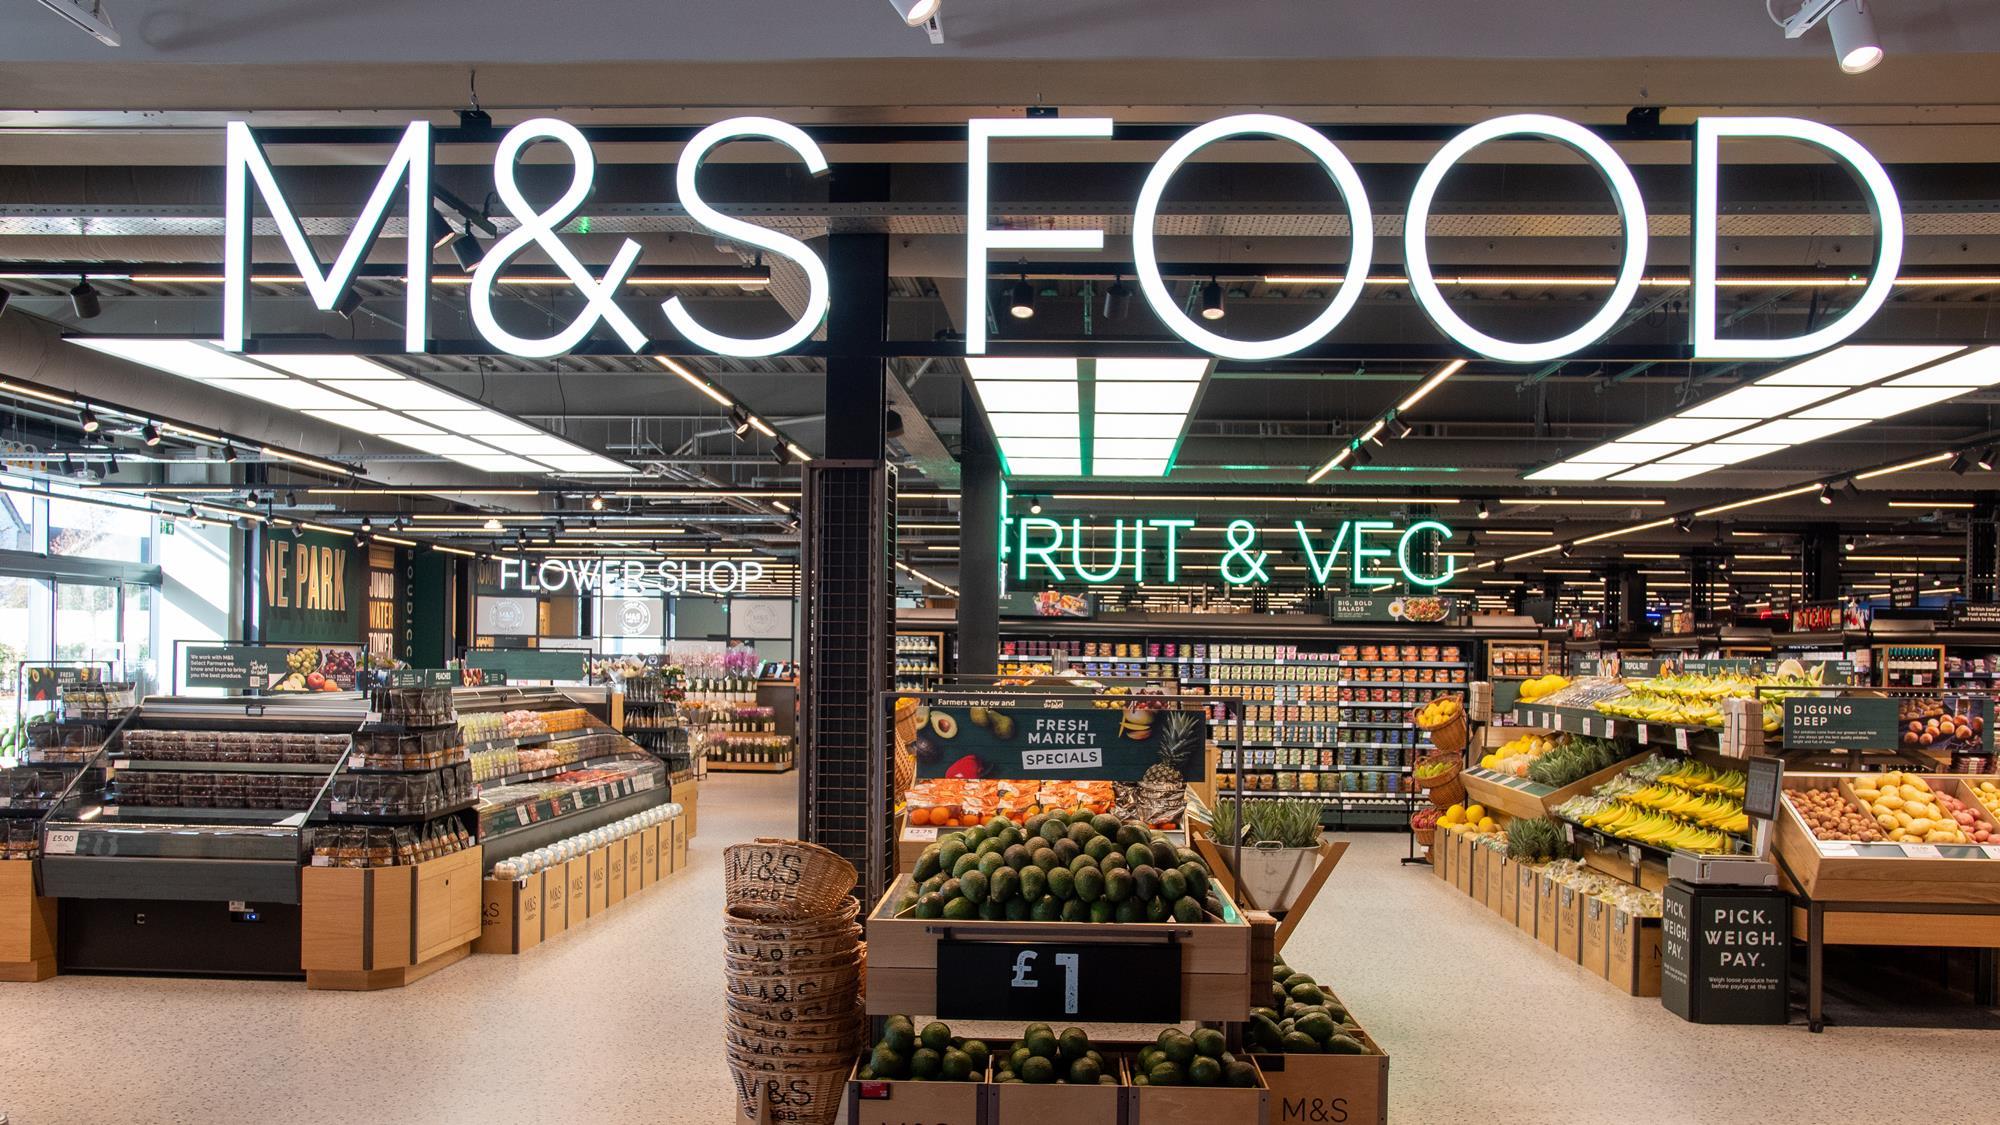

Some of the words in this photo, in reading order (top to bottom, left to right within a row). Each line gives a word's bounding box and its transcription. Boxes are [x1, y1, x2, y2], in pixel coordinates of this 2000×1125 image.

[224, 116, 830, 357] M&S
[965, 114, 1904, 361] FOOD
[1219, 519, 1270, 585] &
[1294, 520, 1455, 587] VEG
[295, 543, 346, 611] PARK
[369, 571, 394, 599] JUMBO
[501, 559, 645, 592] FLOWER
[658, 561, 763, 592] SHOP
[369, 601, 394, 629] WATER
[1797, 607, 1832, 628] STEAK
[368, 632, 394, 658] TOWER
[435, 672, 451, 680] PEACHES
[938, 698, 968, 706] Farmers
[1793, 705, 1852, 715] DIGGING
[1036, 718, 1089, 732] FRESH
[1793, 717, 1828, 726] DEEP
[1027, 732, 1097, 745] MARKET
[1026, 750, 1099, 766] SPECIALS
[52, 834, 74, 842] £5.00
[733, 848, 802, 885] M&S
[741, 888, 781, 901] FOOD
[1666, 899, 1686, 919] PICK.
[1715, 909, 1772, 924] PICK.
[1663, 918, 1689, 942] WEIGH.
[1705, 930, 1783, 946] WEIGH.
[1667, 940, 1684, 960] PAY.
[1720, 952, 1766, 967] PAY.
[1011, 950, 1080, 1014] £1
[1282, 1097, 1349, 1123] M&S
